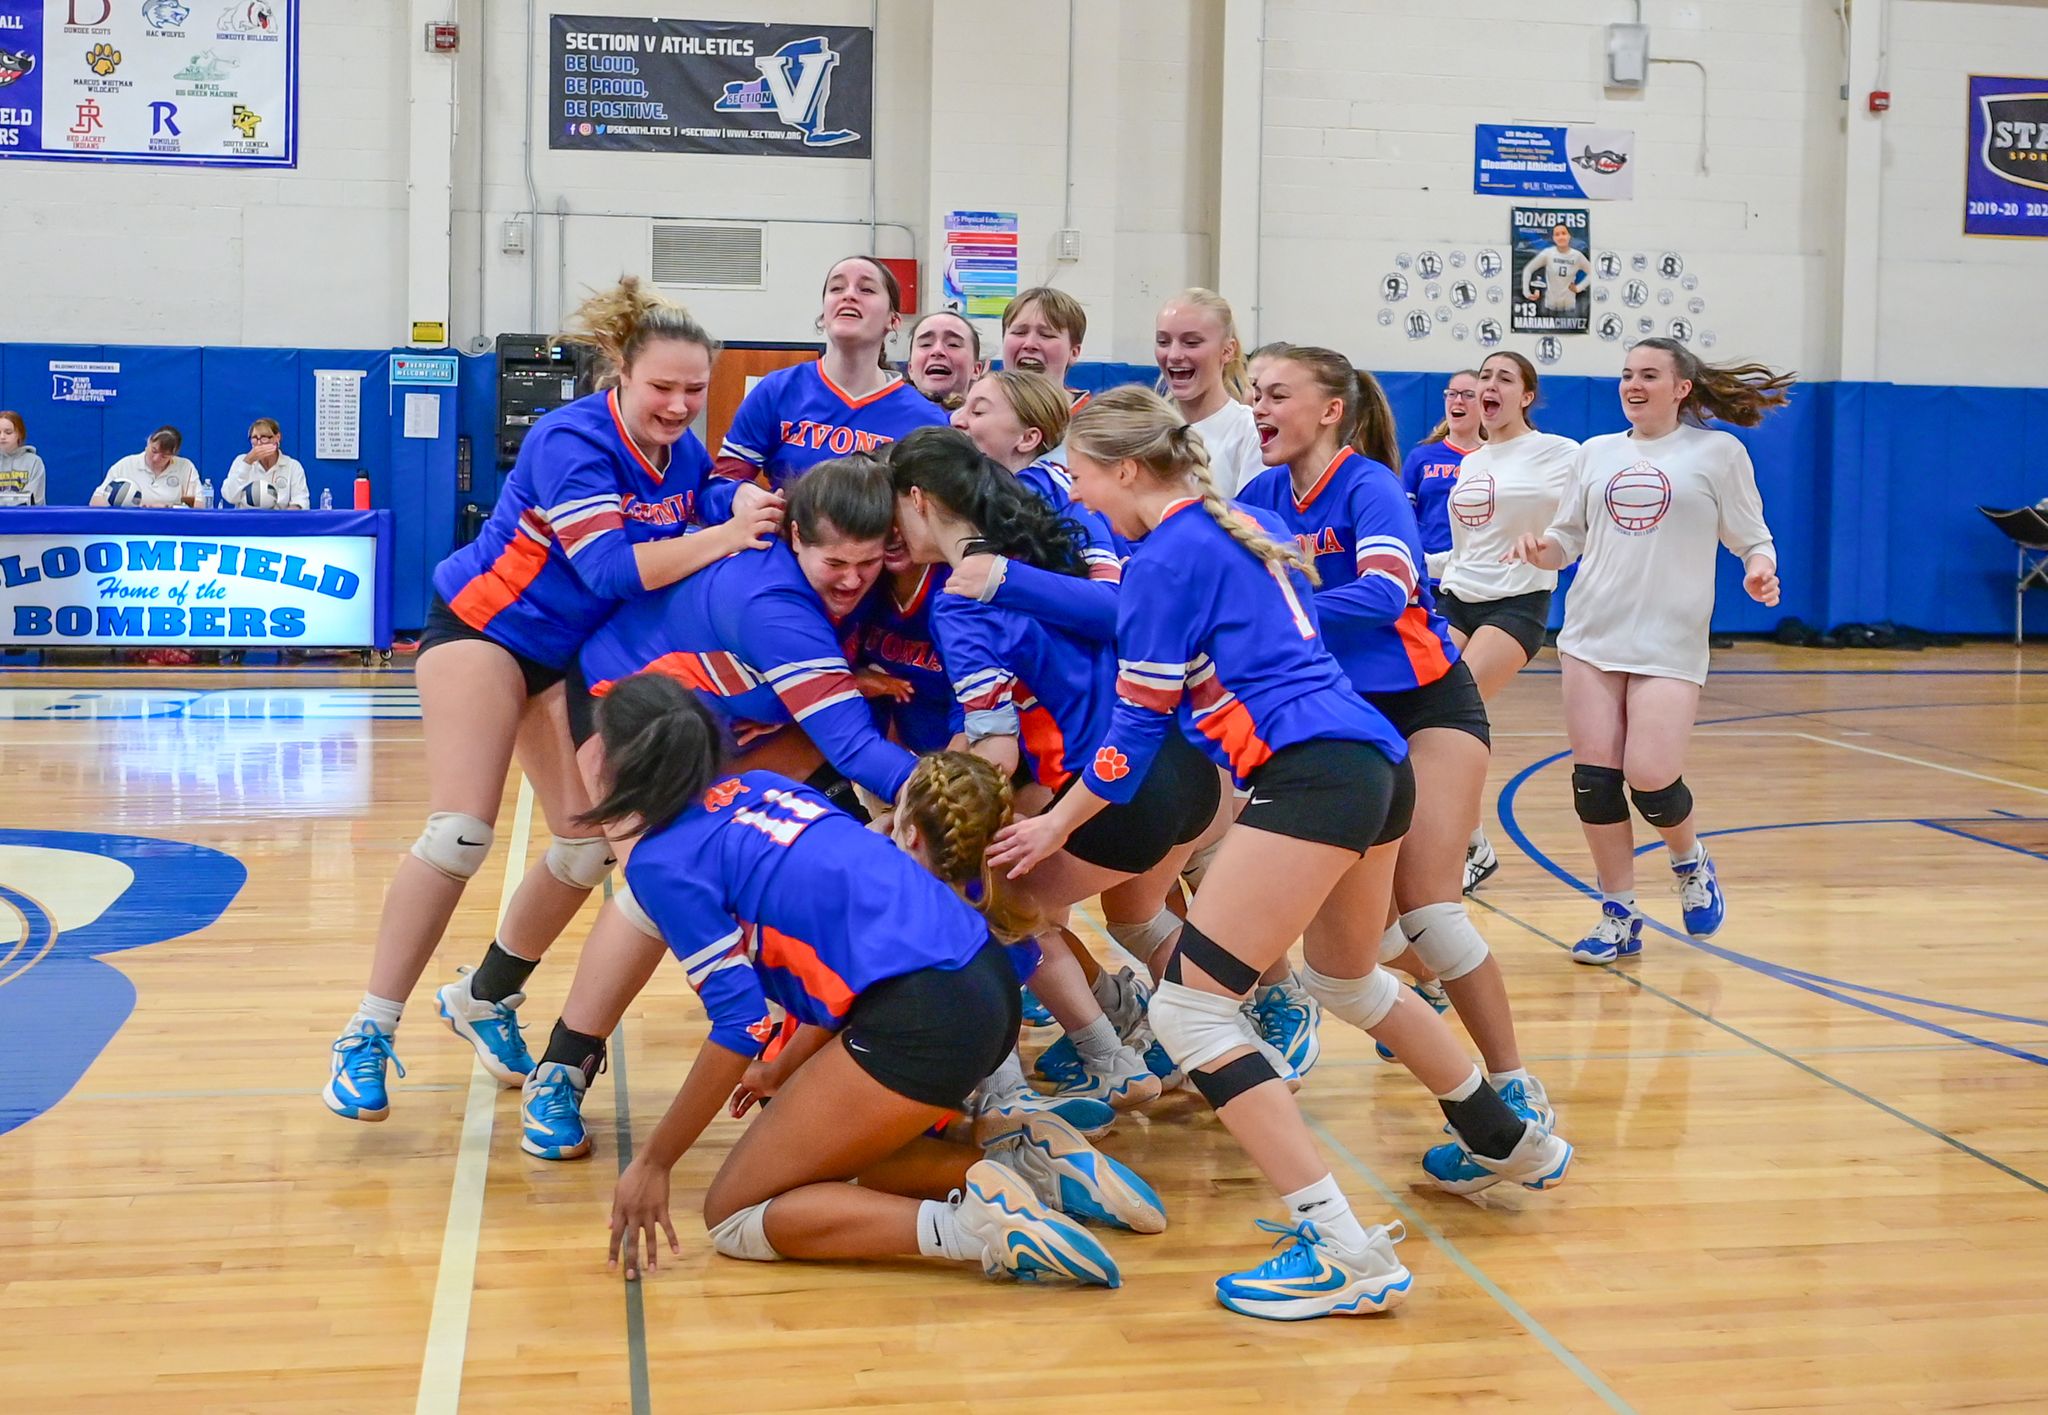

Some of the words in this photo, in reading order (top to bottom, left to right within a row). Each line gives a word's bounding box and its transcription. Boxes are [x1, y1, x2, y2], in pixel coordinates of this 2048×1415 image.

[161, 30, 185, 38] WOLVES
[247, 34, 278, 42] BULLDOGS
[566, 32, 640, 52] SECTION
[643, 35, 656, 53] V
[661, 36, 754, 56] ATHLETICS
[565, 54, 587, 72] BE
[590, 55, 640, 75] LOUD,
[565, 77, 587, 95] BE
[590, 78, 649, 98] PROUD,
[755, 53, 840, 124] V
[727, 92, 772, 104] SECTION
[565, 100, 587, 117] BE
[590, 100, 668, 120] POSITIVE.
[727, 128, 801, 140] WWW.SECTIONV.ORG
[1969, 201, 2019, 217] 2019-20
[1514, 211, 1586, 228] BOMBERS
[1421, 257, 1437, 274] 12
[1559, 266, 1567, 277] 13
[1601, 256, 1614, 275] 7
[1663, 257, 1676, 275] 8
[1387, 278, 1400, 297] 9
[1514, 303, 1537, 317] #13
[1410, 315, 1425, 333] 10
[1481, 321, 1497, 340] 5
[1603, 318, 1615, 336] 6
[1672, 322, 1685, 339] 3
[397, 369, 428, 377] WELCOME
[52, 374, 74, 400] B
[780, 420, 894, 455] LIVON
[0, 540, 360, 600] LOOMFIELD
[97, 576, 161, 600] Home
[168, 579, 191, 606] of
[196, 578, 226, 600] the
[14, 605, 306, 638] BOMBERS
